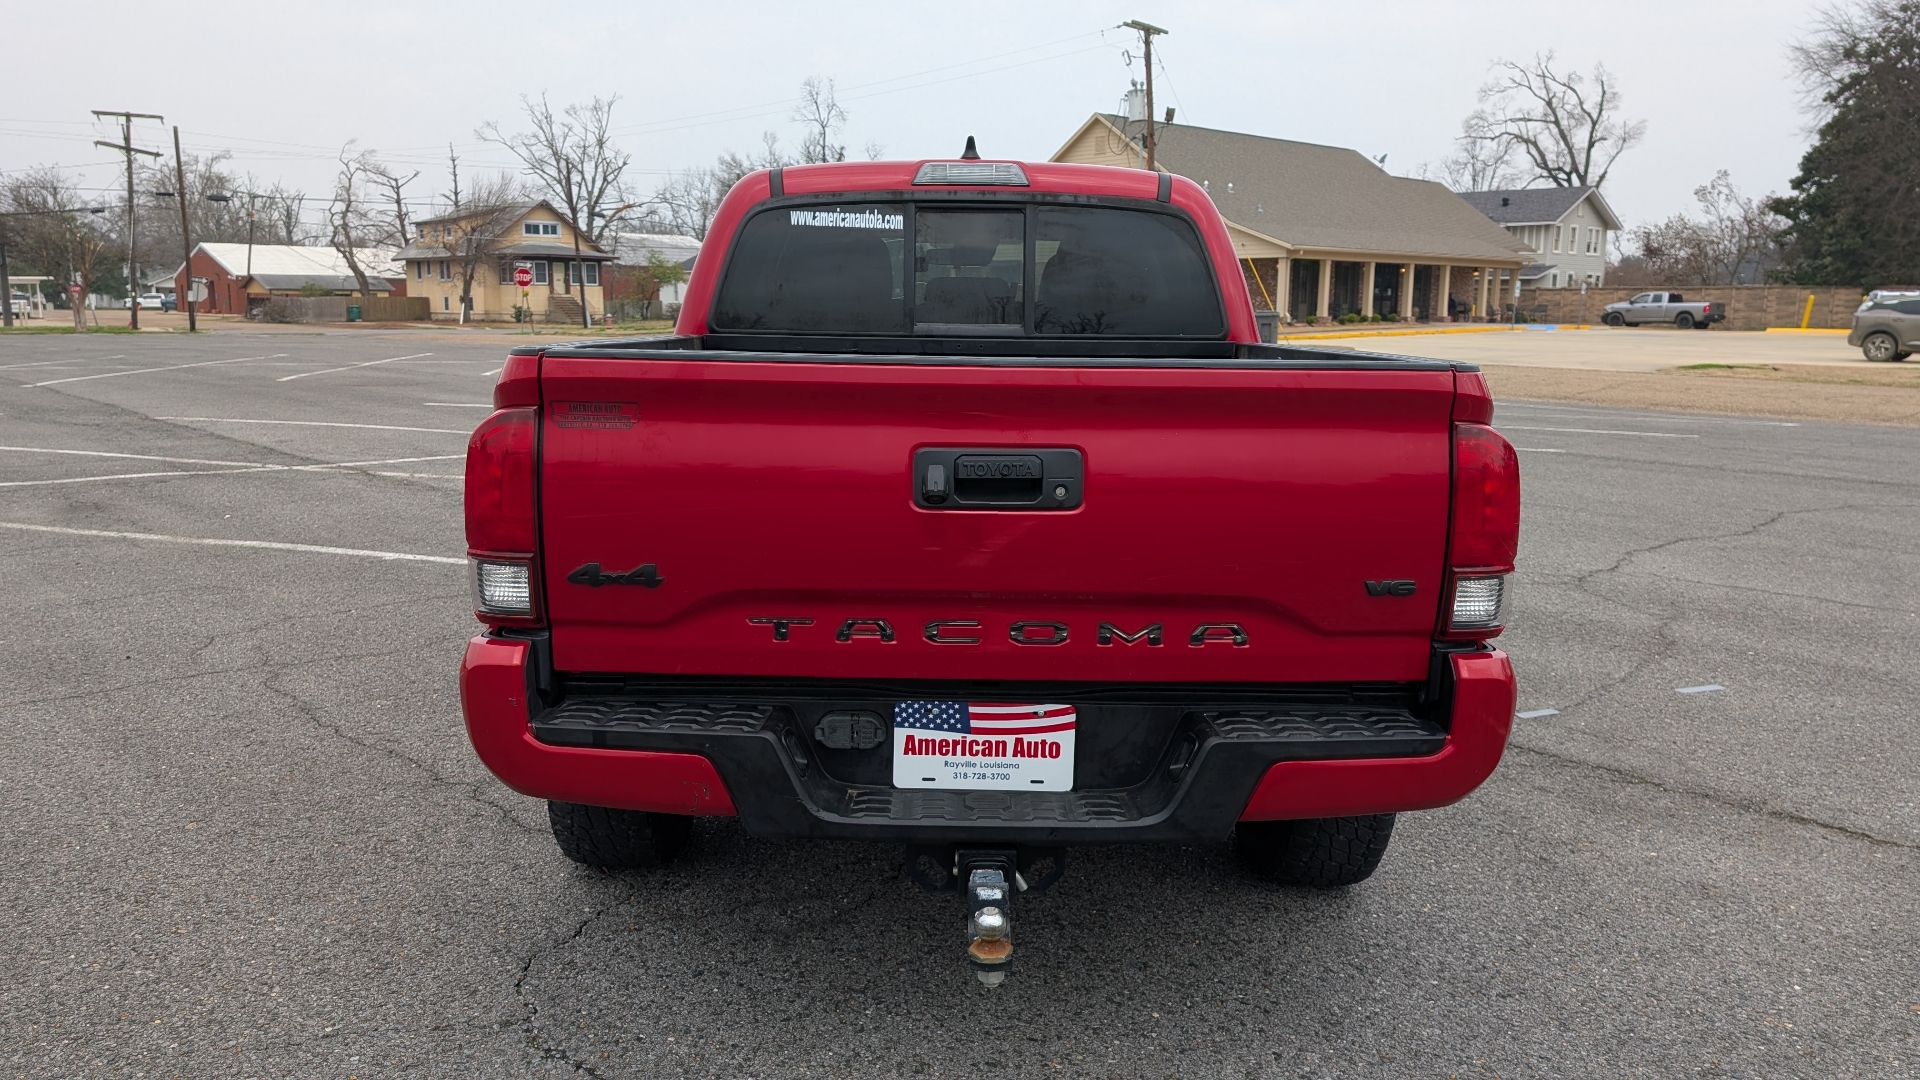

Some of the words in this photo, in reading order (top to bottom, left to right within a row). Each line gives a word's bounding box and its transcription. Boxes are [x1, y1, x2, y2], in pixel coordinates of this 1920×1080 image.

[790, 208, 903, 229] www.americanautola.com
[568, 404, 602, 413] AMERICAN
[604, 405, 622, 413] AUTO
[963, 462, 1036, 477] TOYOTA
[1364, 579, 1416, 596] V6
[746, 617, 1249, 648] TACOMA
[903, 734, 1008, 758] American
[1012, 737, 1061, 759] Auto
[944, 760, 977, 769] Rayville
[979, 761, 1020, 769] Louisiana
[952, 772, 1011, 780] 318-728-3700
